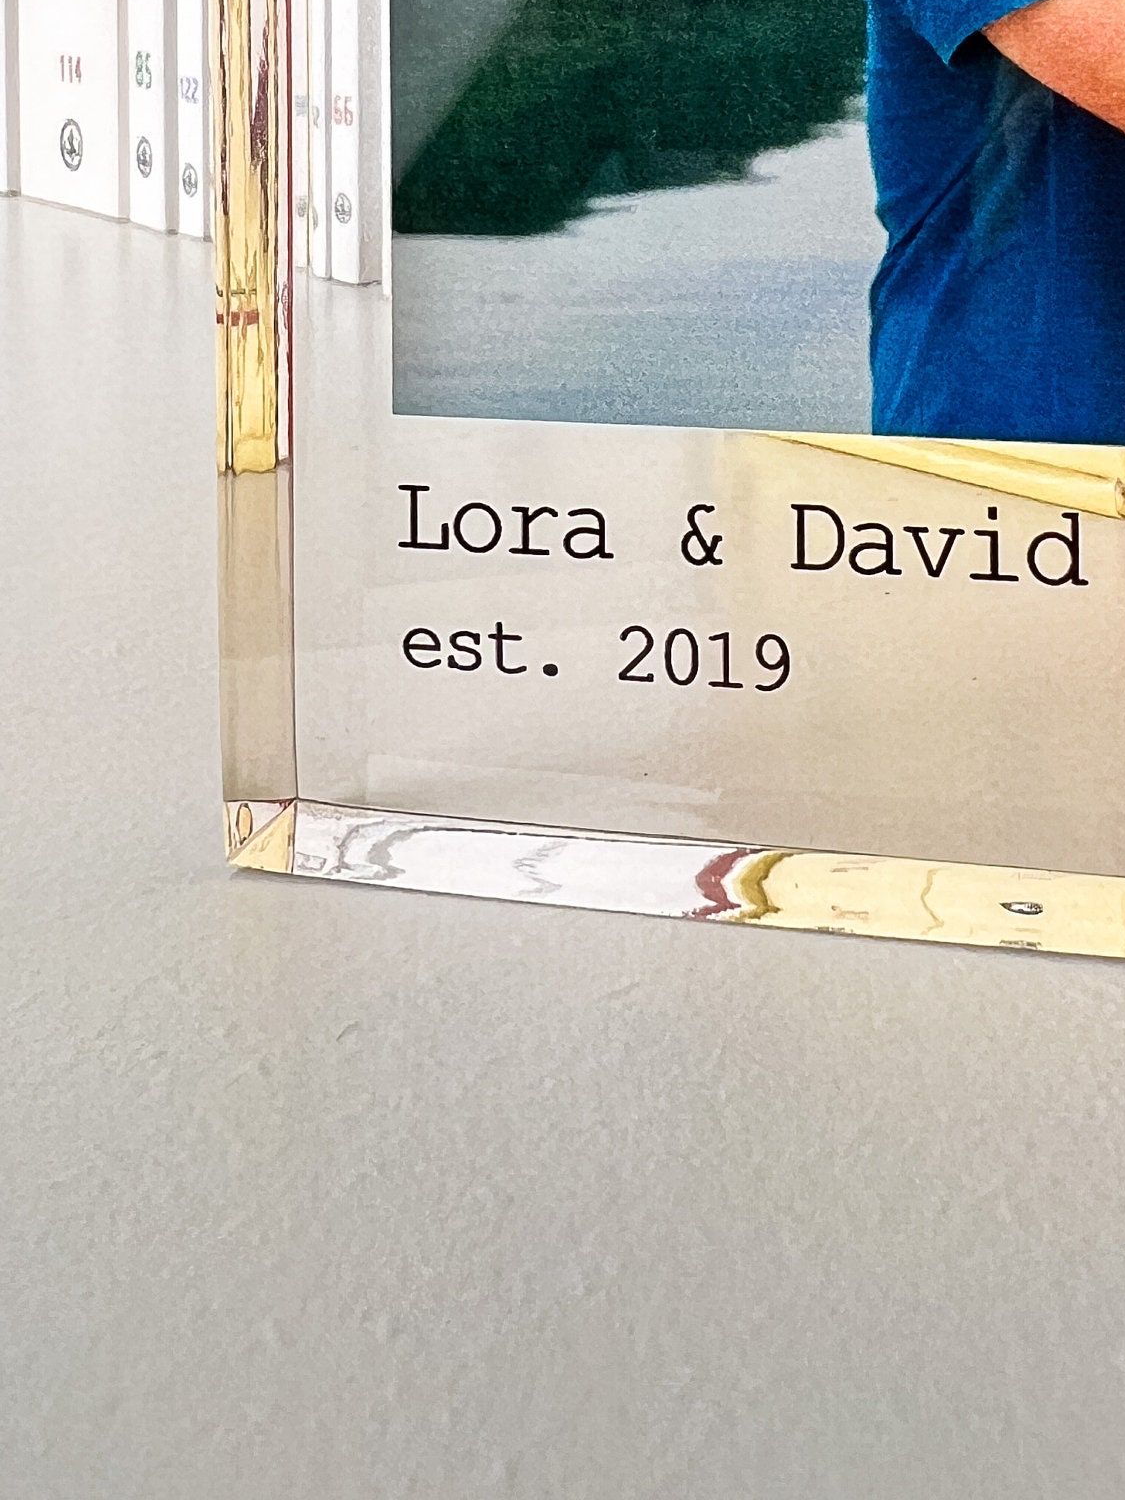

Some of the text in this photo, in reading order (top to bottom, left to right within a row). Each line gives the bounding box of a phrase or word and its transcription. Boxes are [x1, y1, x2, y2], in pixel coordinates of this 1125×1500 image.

[398, 483, 1090, 587] Lora & David
[401, 621, 792, 692] est. 2019
